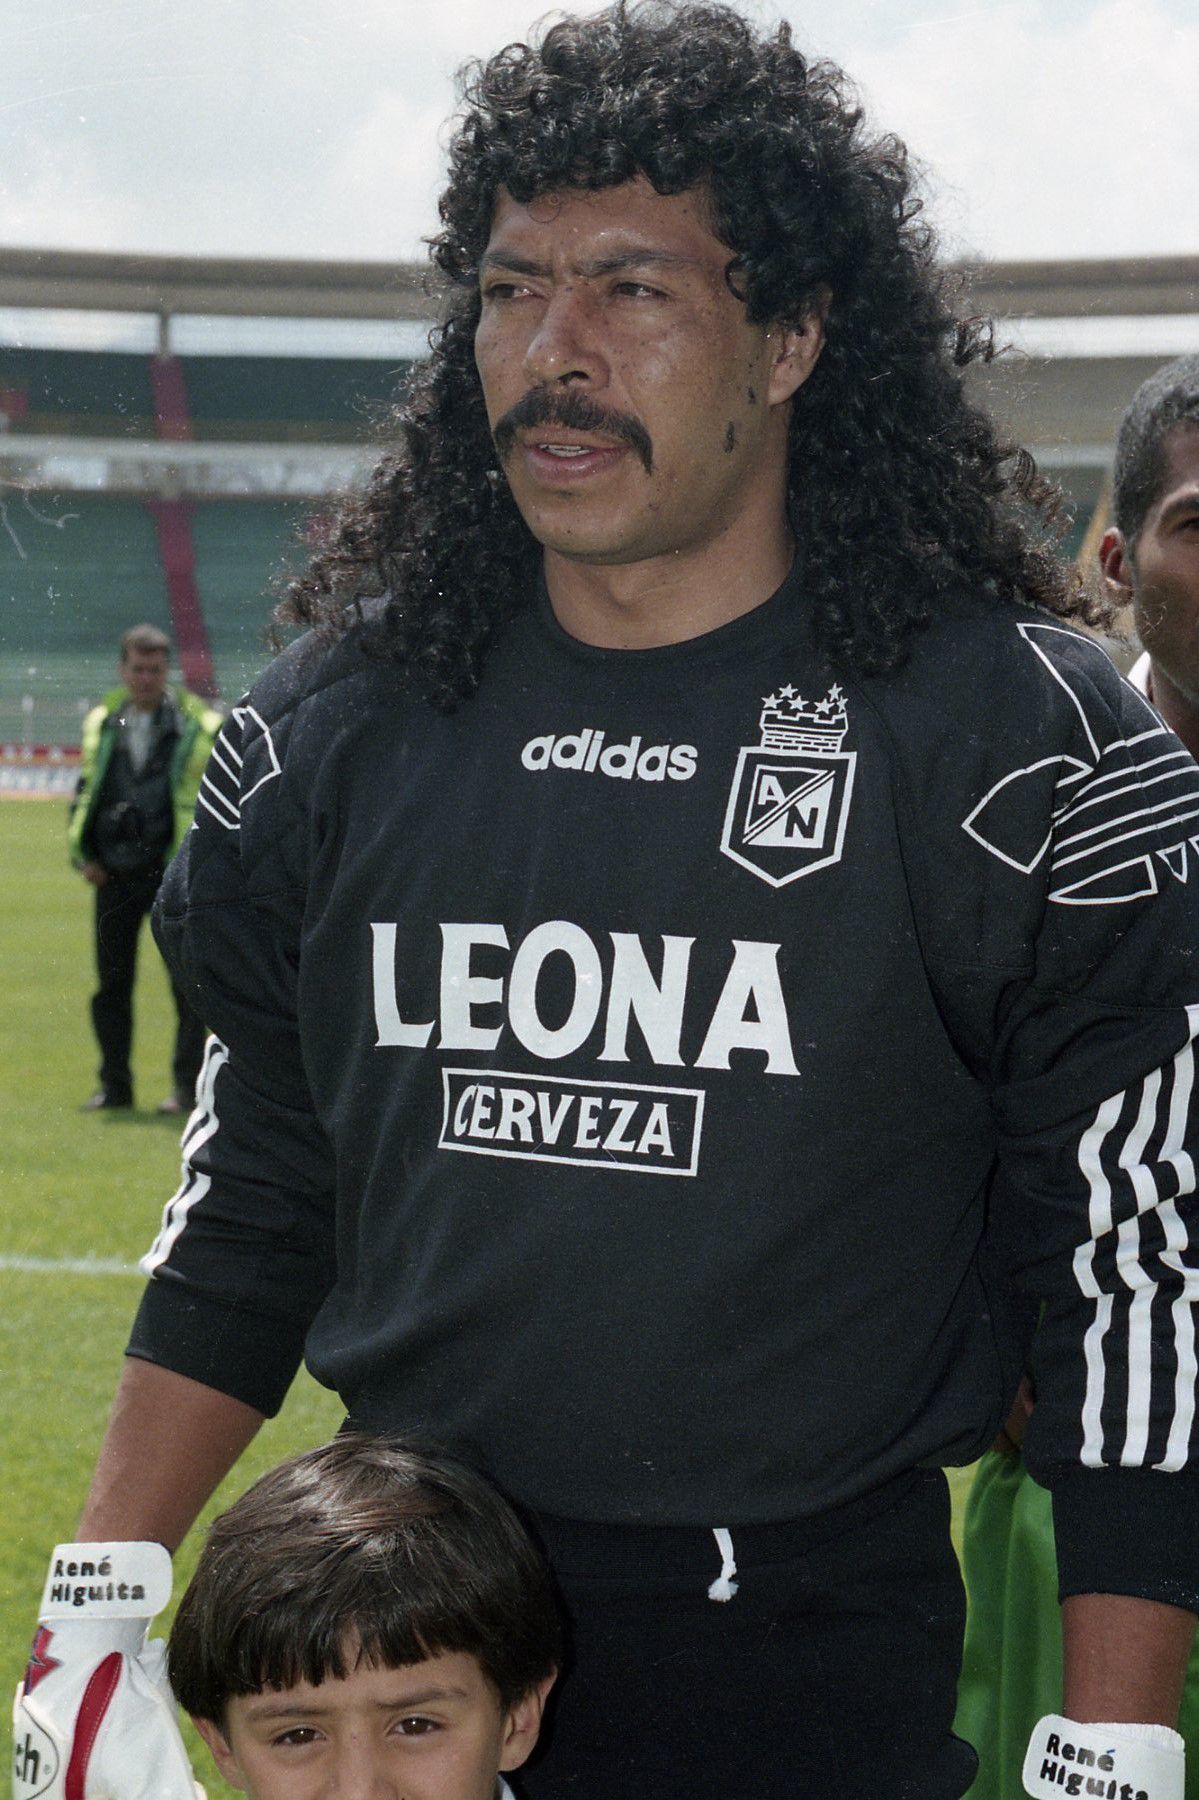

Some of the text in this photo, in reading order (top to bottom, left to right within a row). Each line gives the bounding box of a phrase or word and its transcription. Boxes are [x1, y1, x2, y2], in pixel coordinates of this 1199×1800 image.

[521, 728, 698, 781] adidas
[370, 920, 801, 1075] LEONA
[453, 1083, 675, 1157] CERVEZA
[53, 1555, 112, 1577] René
[50, 1583, 146, 1606] Higuita
[1046, 1733, 1115, 1772] René
